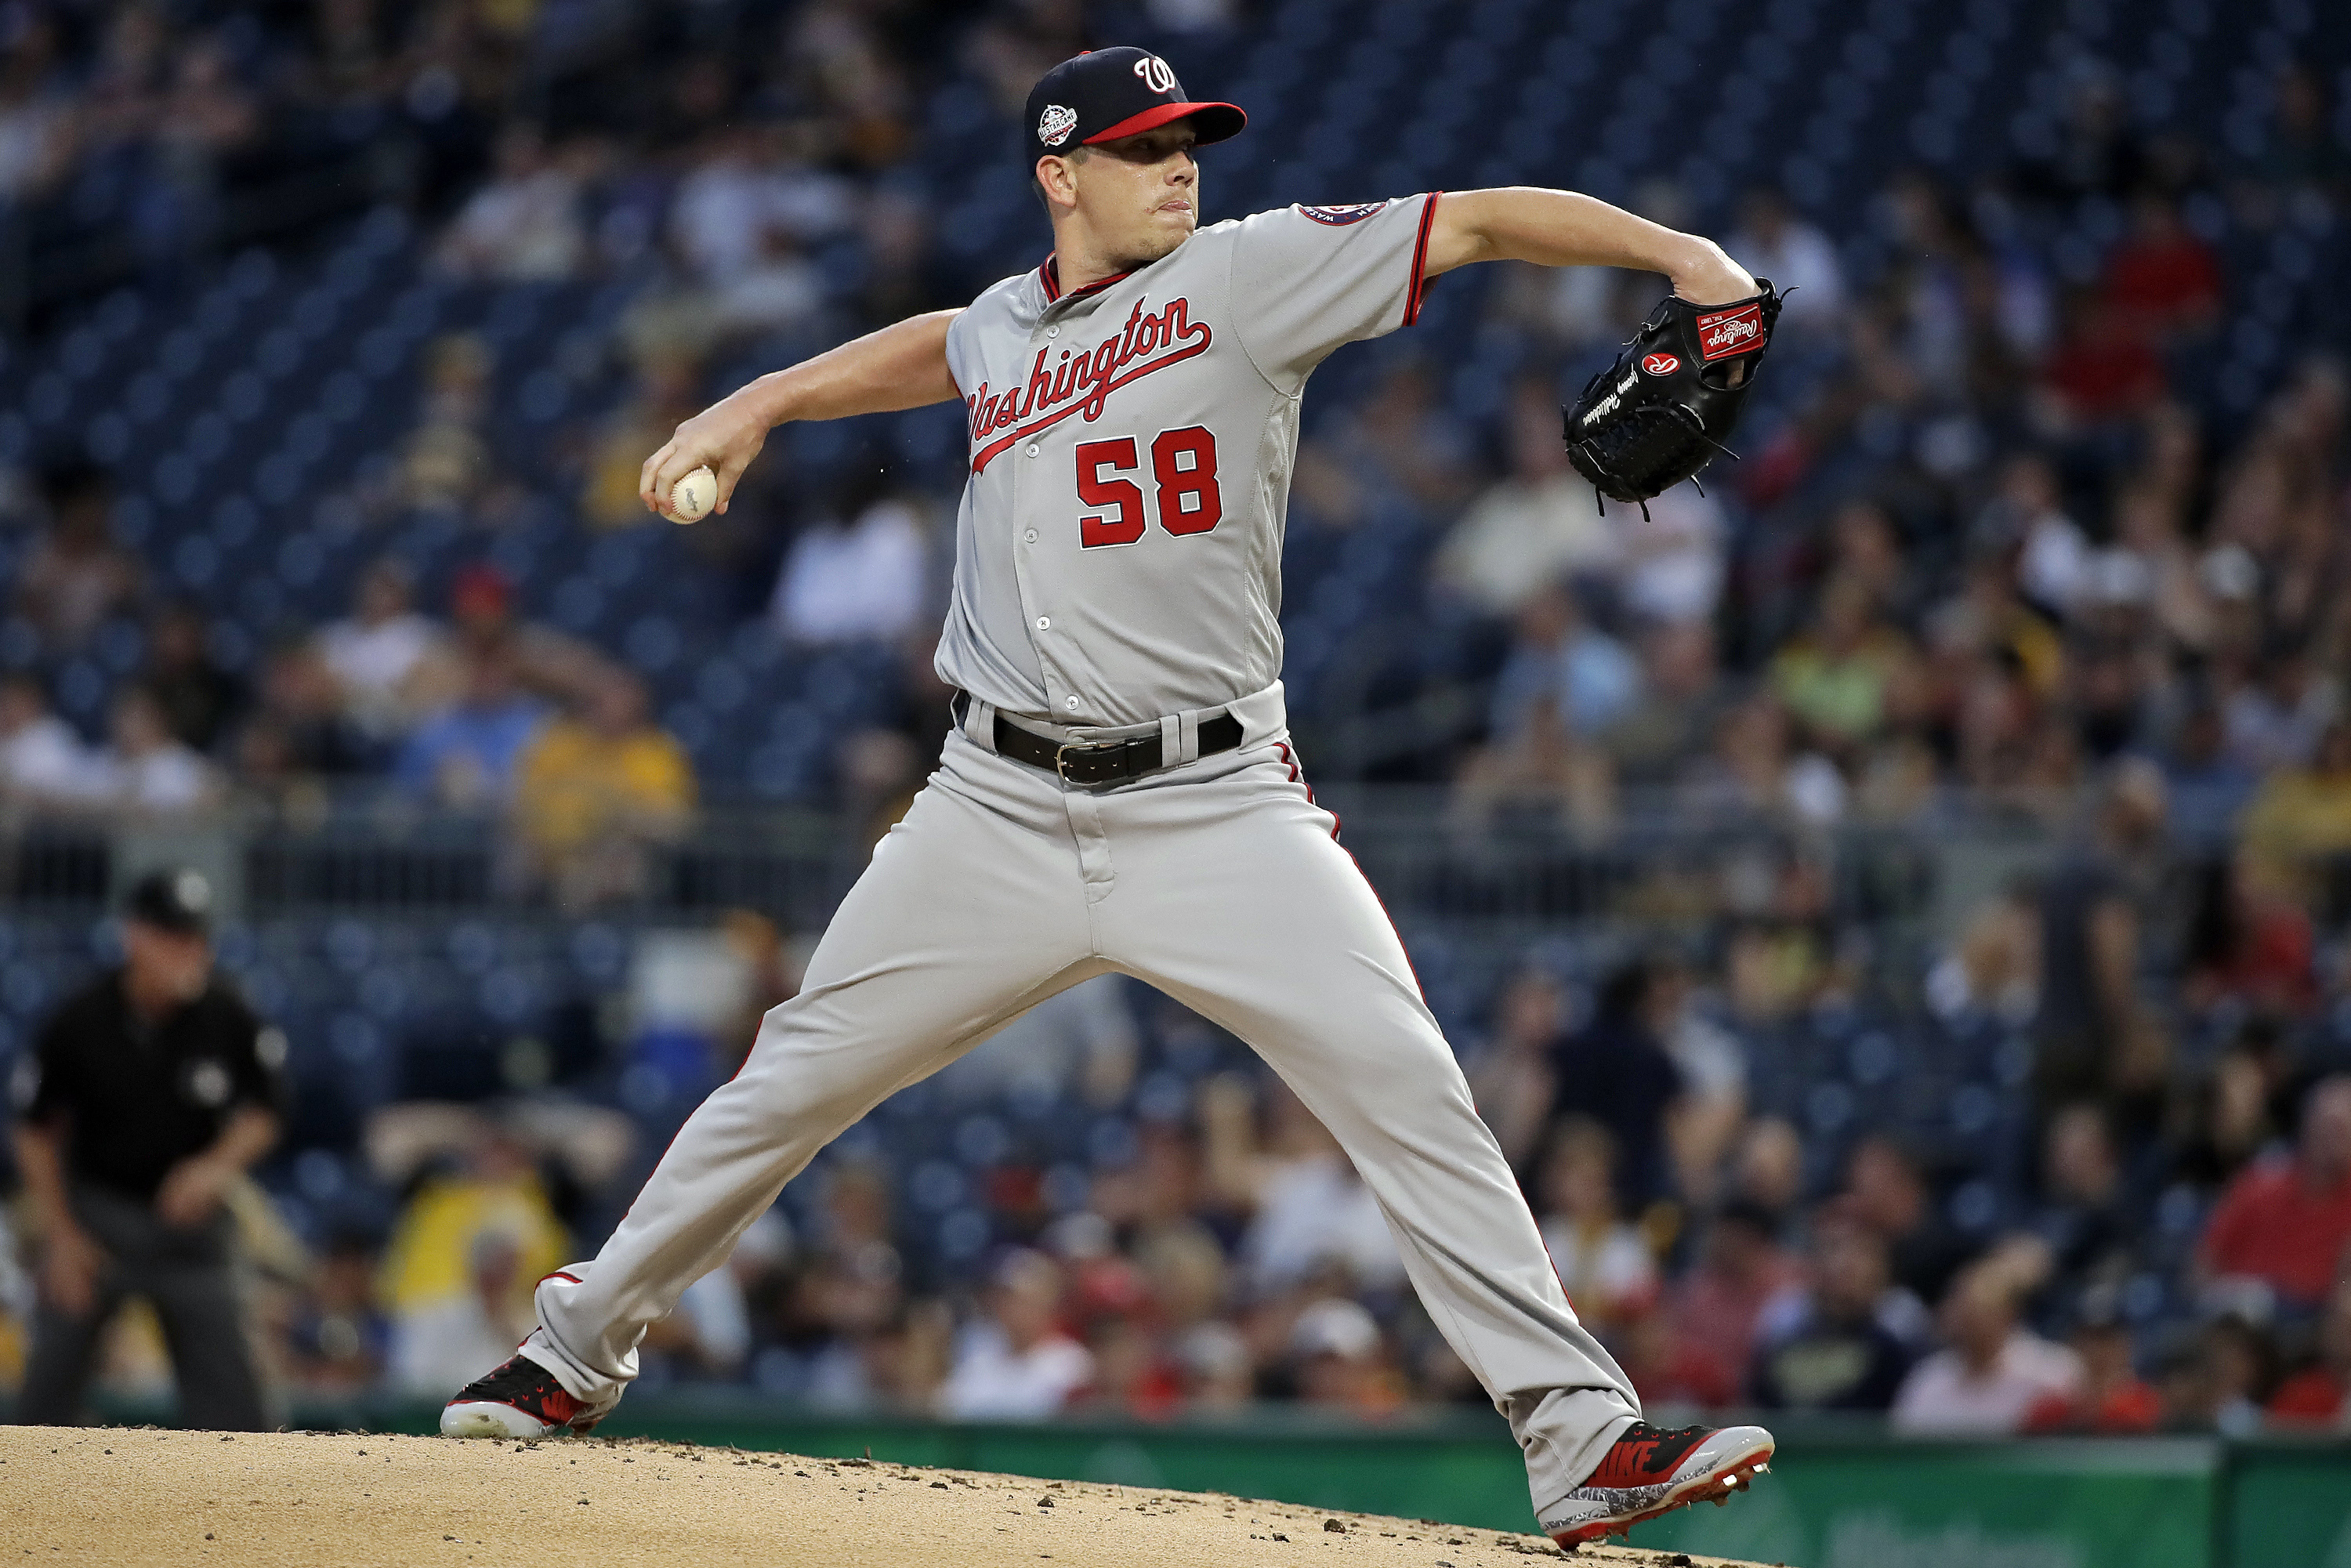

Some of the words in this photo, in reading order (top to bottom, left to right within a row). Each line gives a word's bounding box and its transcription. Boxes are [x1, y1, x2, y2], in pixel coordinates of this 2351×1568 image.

[1133, 56, 1176, 94] W
[1707, 319, 1758, 347] Rawlings
[968, 292, 1212, 476] Washington
[1074, 424, 1223, 550] 58
